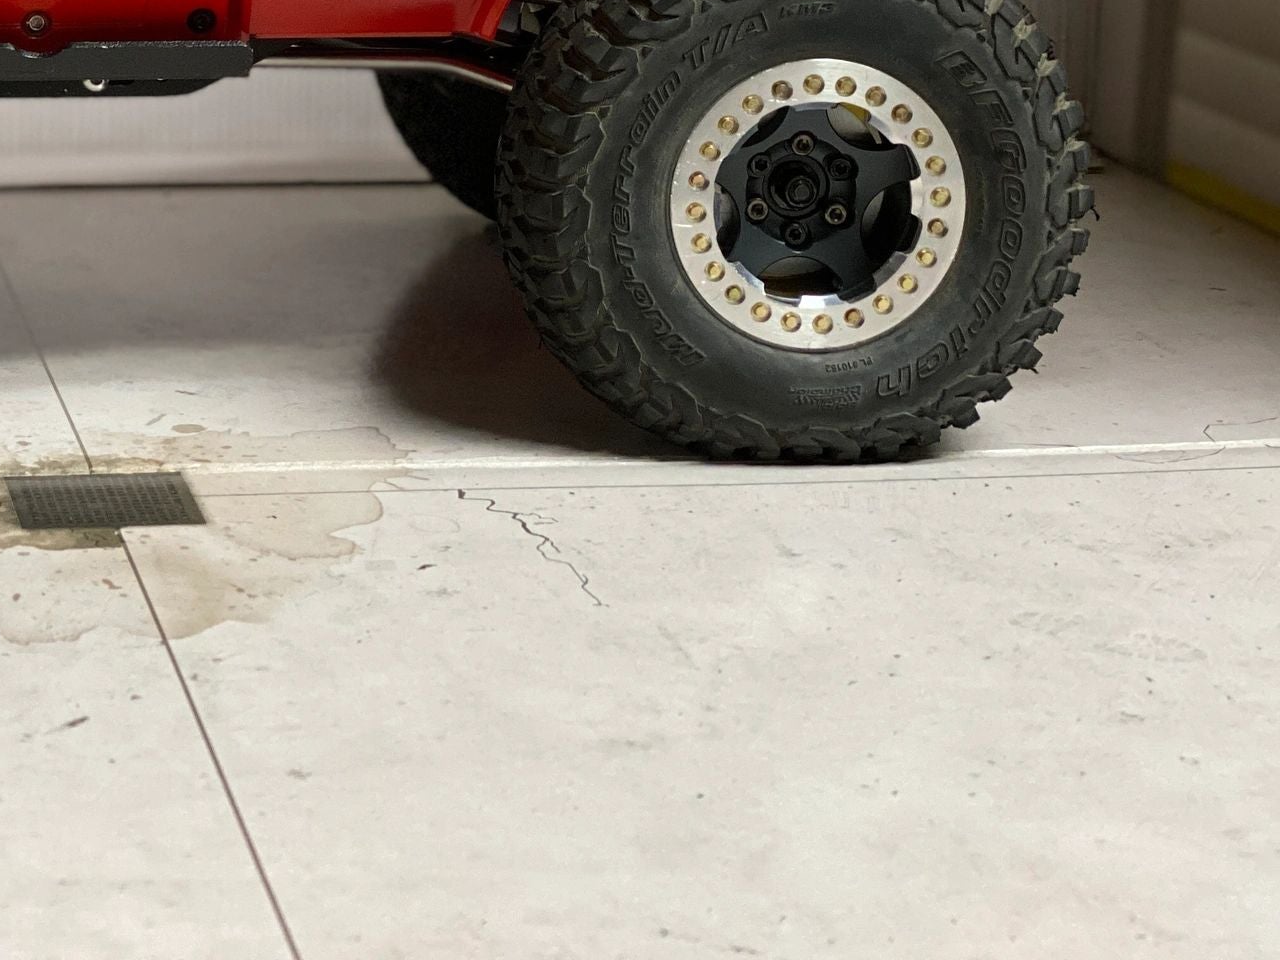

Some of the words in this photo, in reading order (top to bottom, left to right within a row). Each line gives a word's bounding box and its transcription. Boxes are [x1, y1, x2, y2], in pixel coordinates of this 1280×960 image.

[610, 69, 707, 368] Mud-Terrain
[682, 11, 768, 70] T/A
[876, 49, 1027, 396] BFGoodrich
